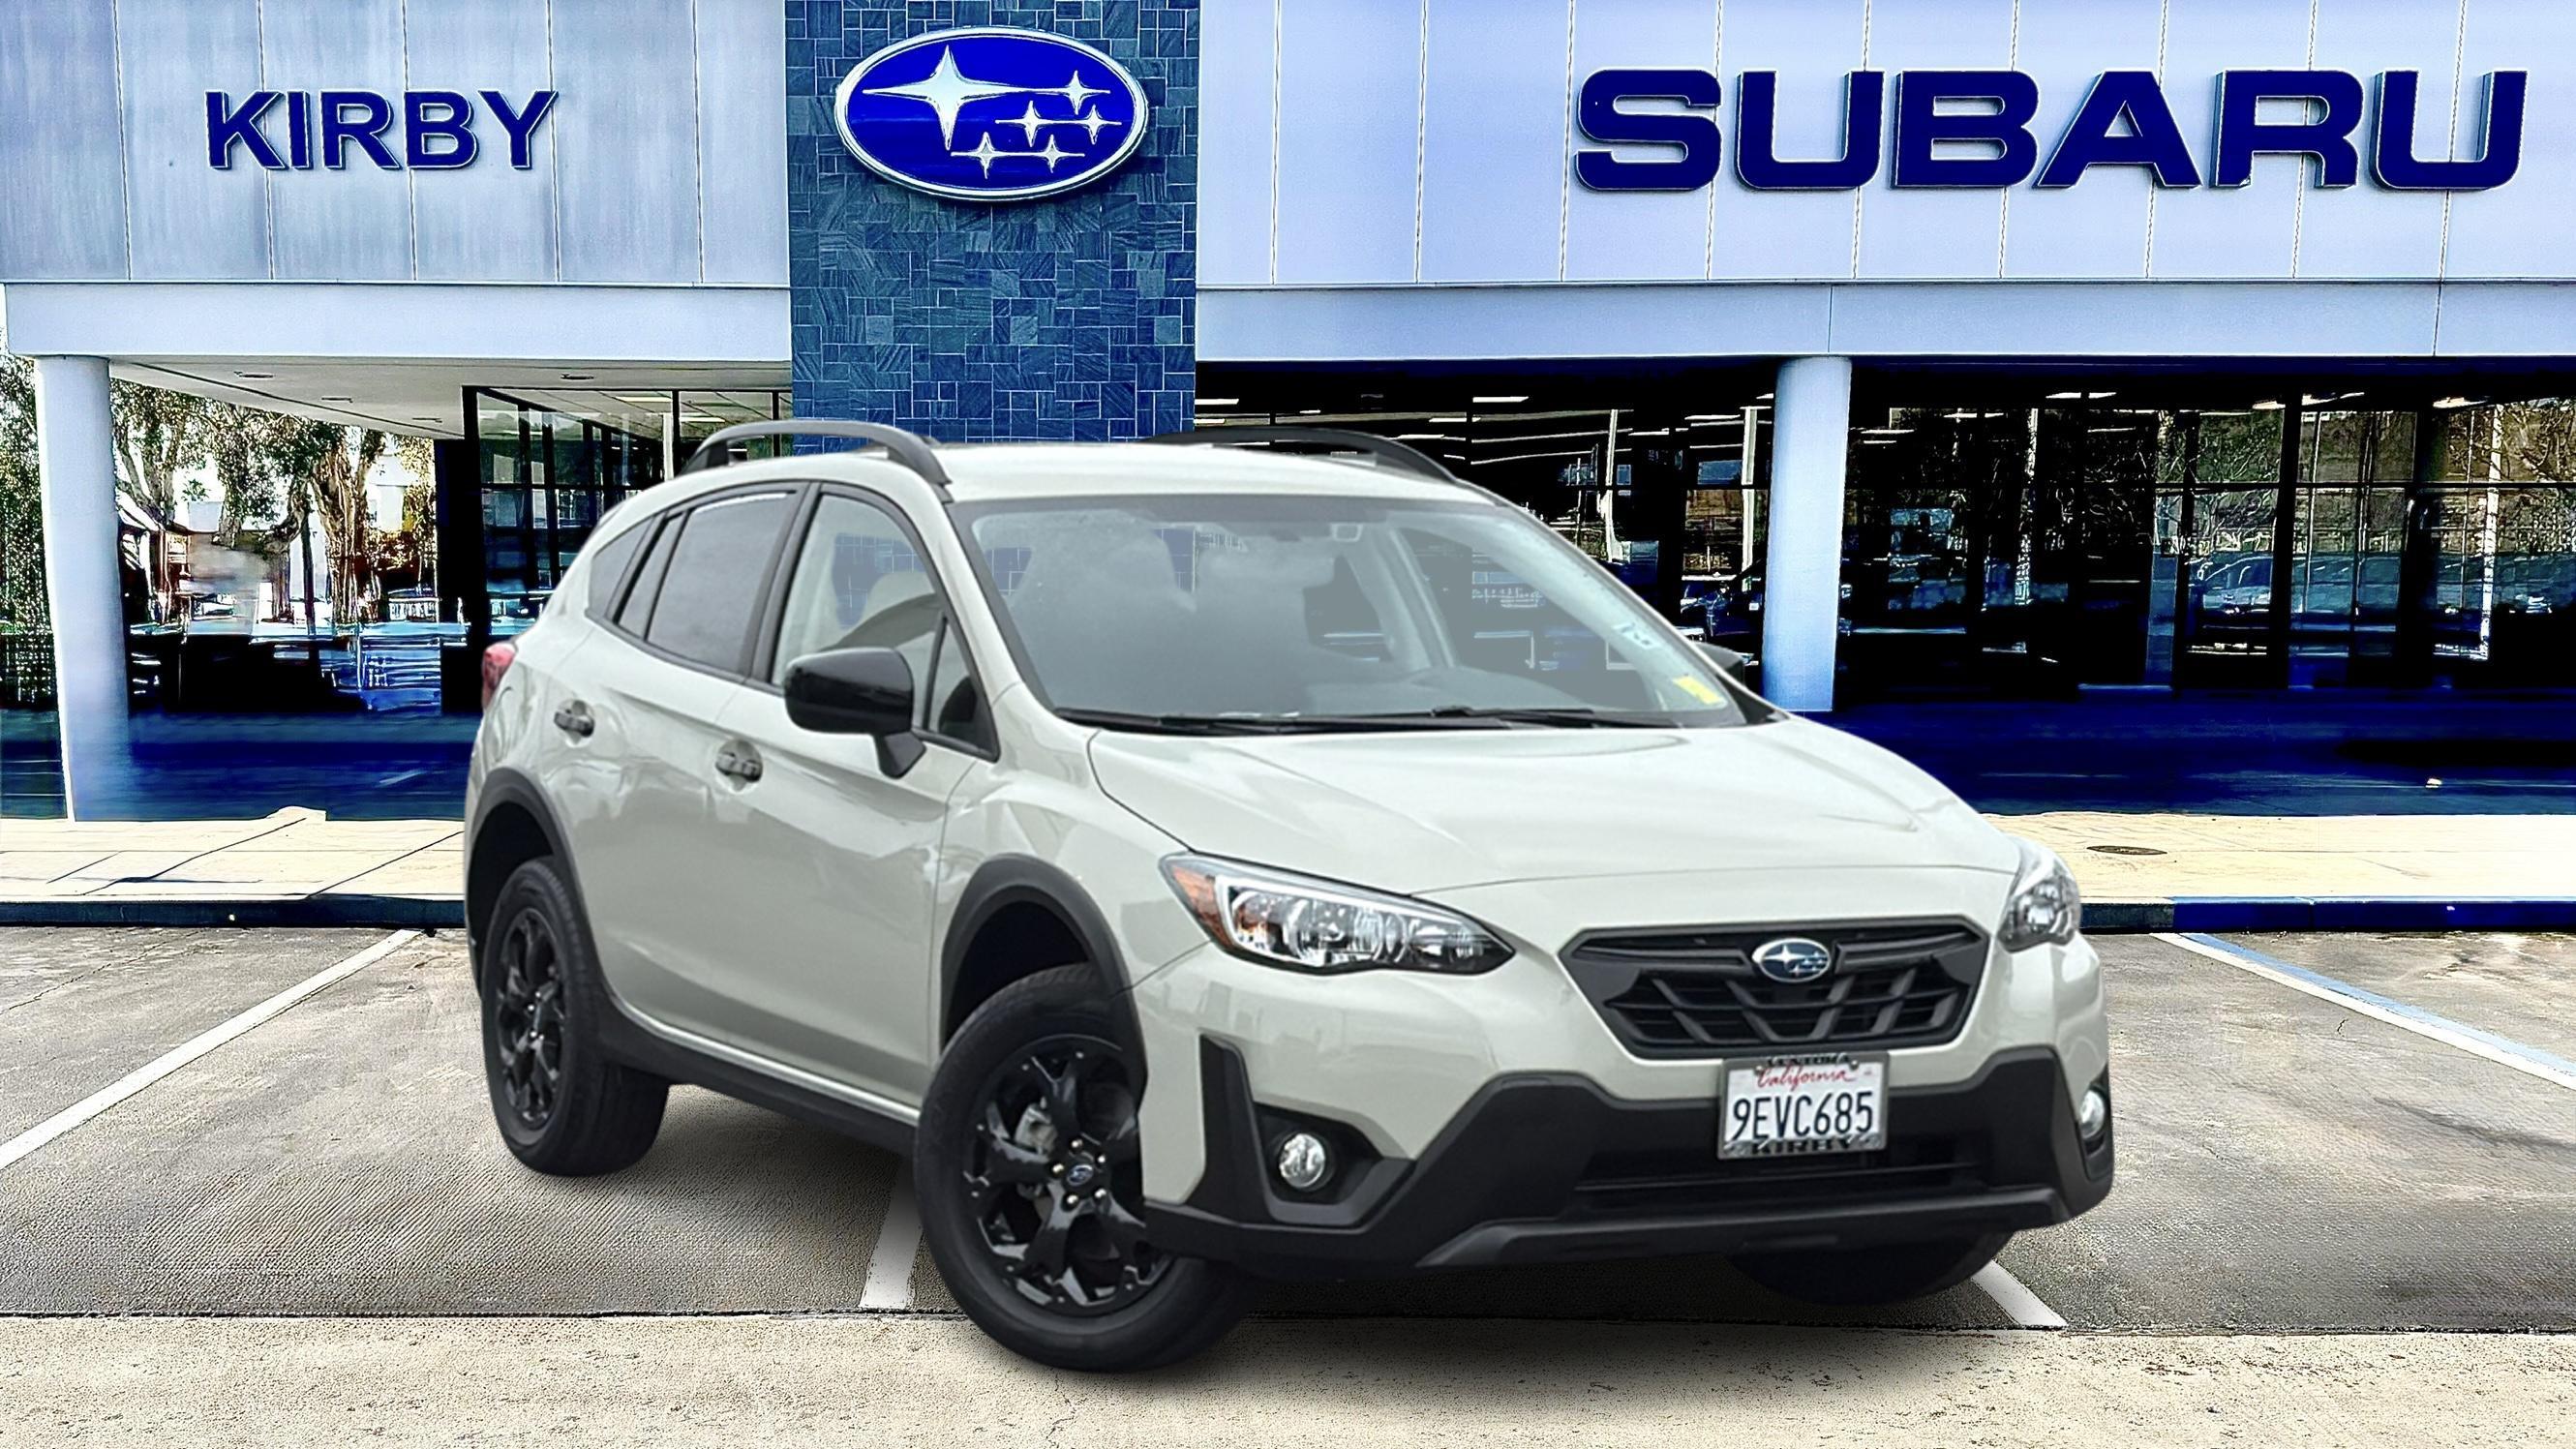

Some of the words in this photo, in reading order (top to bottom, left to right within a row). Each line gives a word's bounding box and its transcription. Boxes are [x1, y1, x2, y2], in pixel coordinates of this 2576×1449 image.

[204, 90, 559, 170] KIRBY
[1575, 69, 2528, 192] SUBARU
[1757, 1065, 1856, 1091] California
[1732, 1091, 1873, 1141] 9EVC685
[1751, 1137, 1853, 1155] KIRBY
